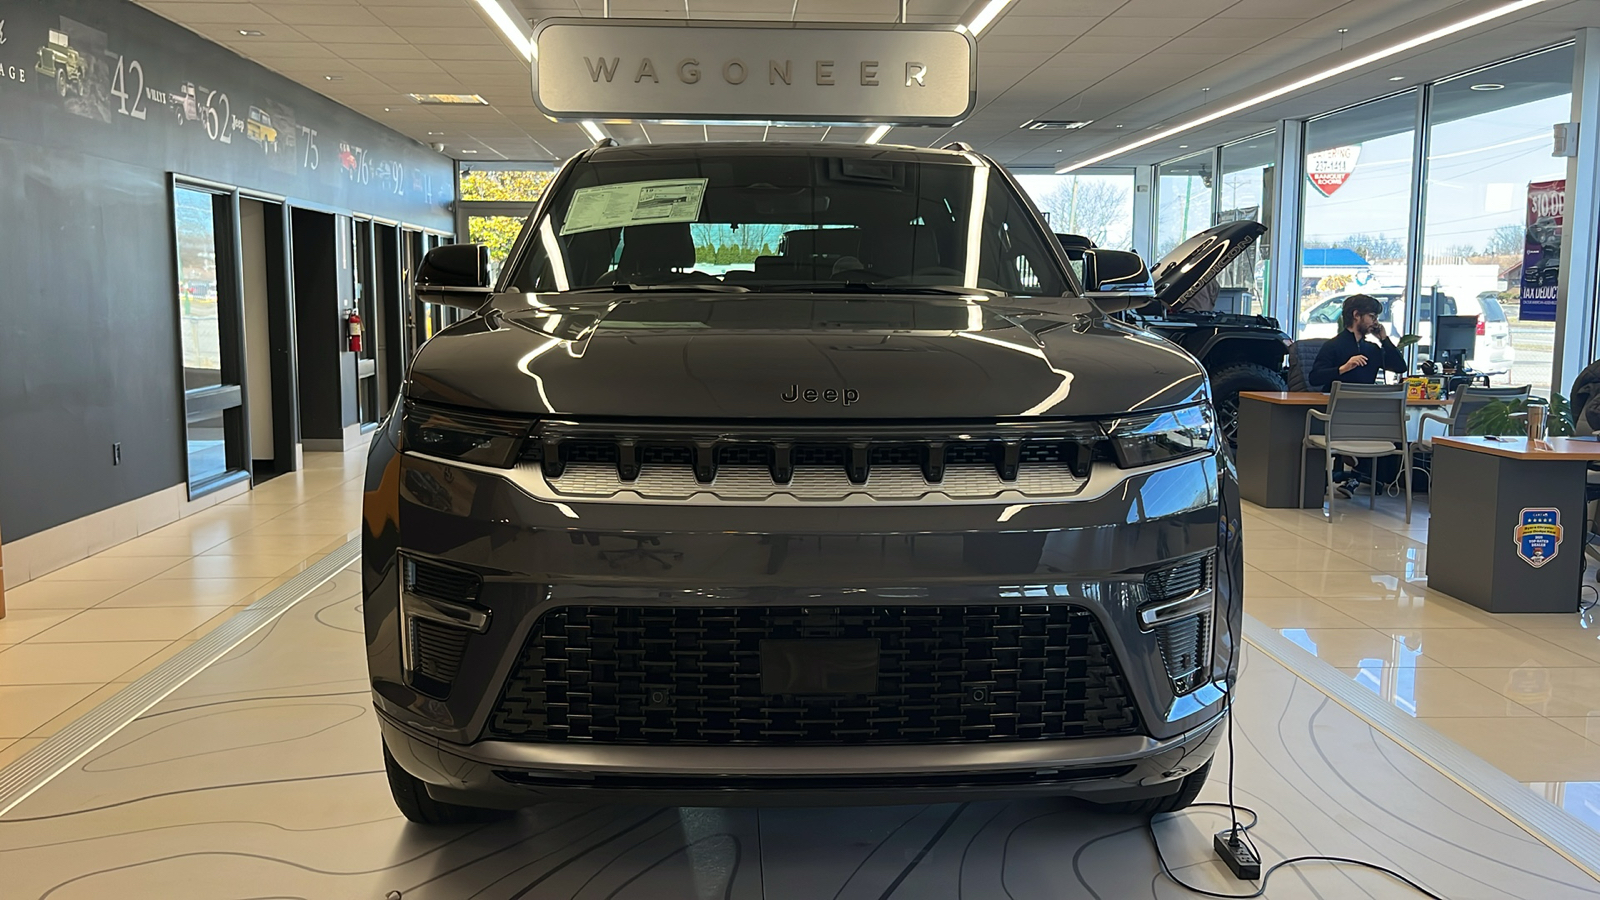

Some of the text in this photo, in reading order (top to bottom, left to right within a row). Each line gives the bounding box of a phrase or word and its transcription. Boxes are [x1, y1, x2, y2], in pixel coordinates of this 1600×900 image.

[110, 55, 147, 120] 42
[583, 56, 927, 88] WAGONEER
[206, 90, 231, 144] 62
[302, 126, 319, 170] 75
[1179, 235, 1253, 304] RUBICON
[780, 384, 860, 407] Jeep
